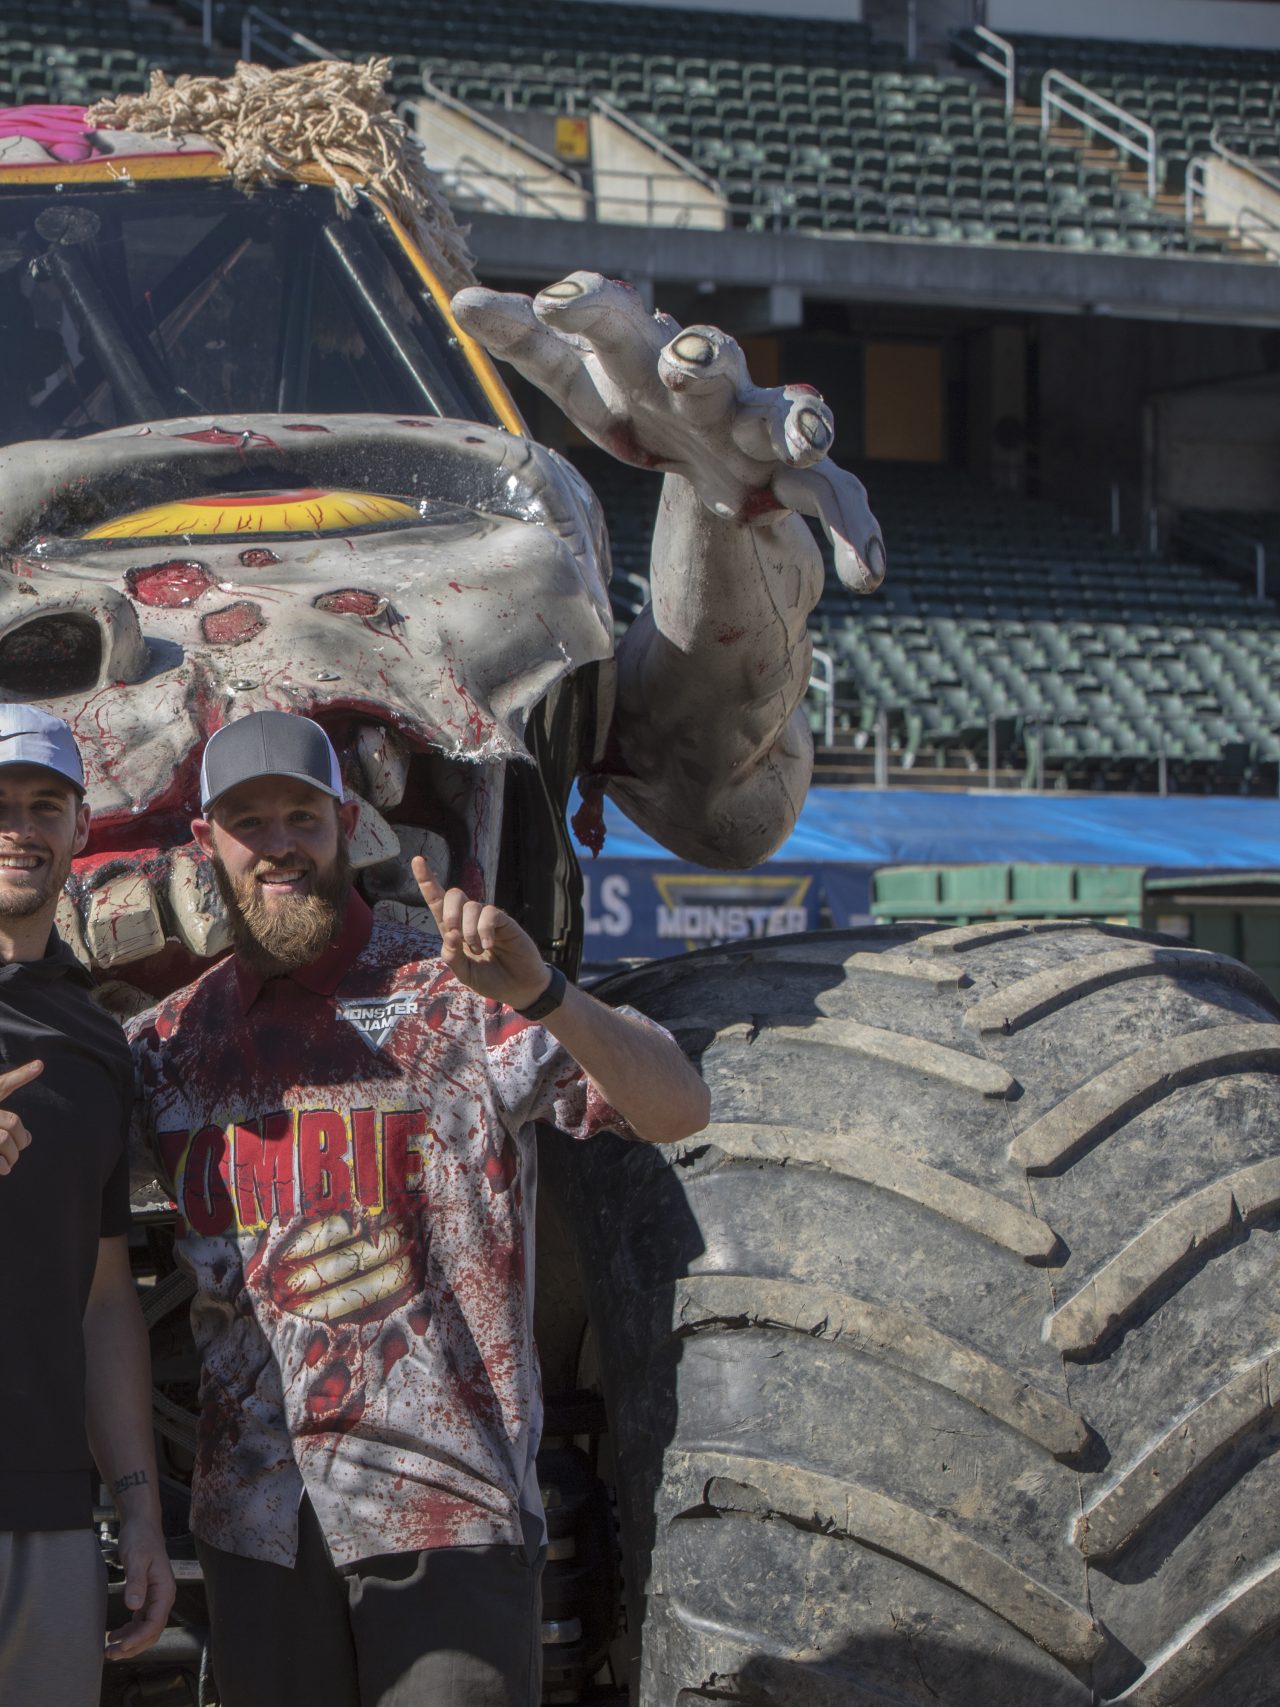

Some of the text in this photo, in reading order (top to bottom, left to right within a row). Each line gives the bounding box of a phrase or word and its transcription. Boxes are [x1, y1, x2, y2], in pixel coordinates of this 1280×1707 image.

[656, 904, 808, 938] MONSTER
[335, 1002, 419, 1021] MONSTER
[360, 1015, 395, 1032] JAM
